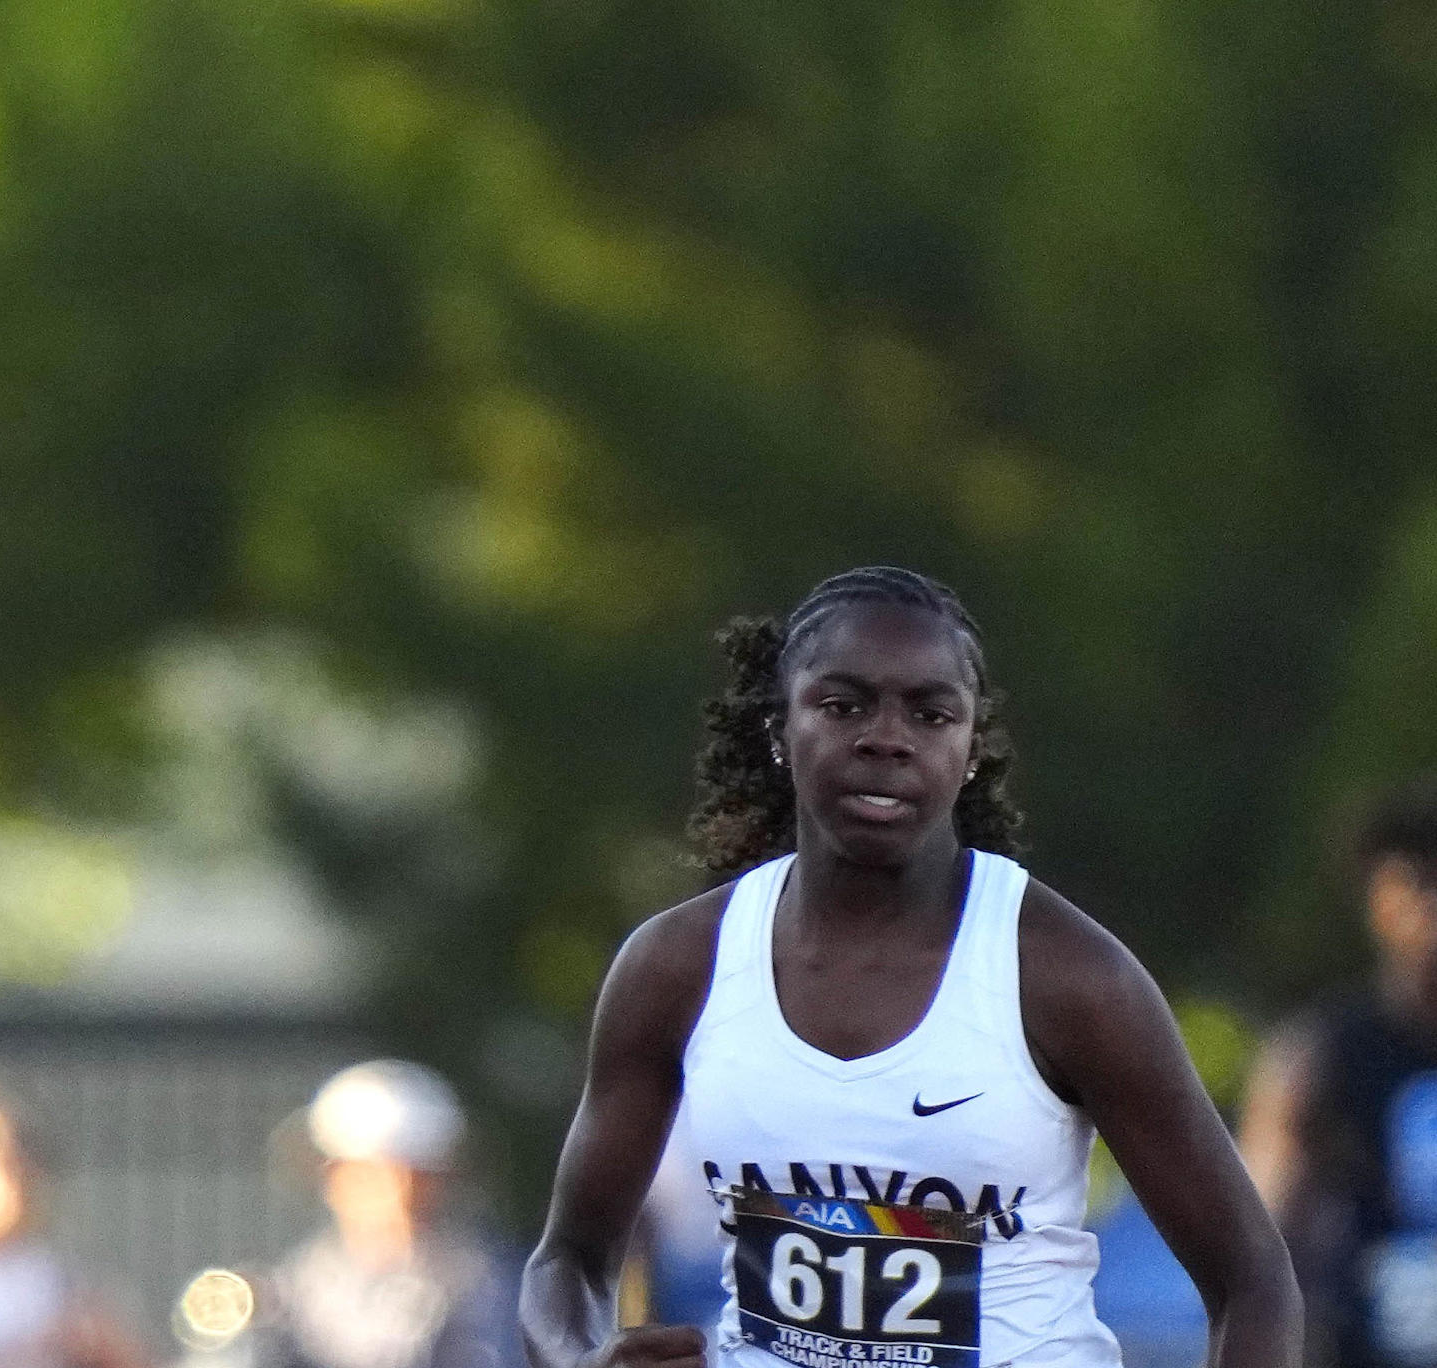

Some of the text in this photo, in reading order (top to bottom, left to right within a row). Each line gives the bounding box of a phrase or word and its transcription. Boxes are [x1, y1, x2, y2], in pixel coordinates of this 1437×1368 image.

[703, 1160, 1027, 1241] ANYON
[795, 1202, 856, 1230] AIA
[769, 1232, 942, 1334] 612
[777, 1328, 934, 1364] TRACK & FIELD
